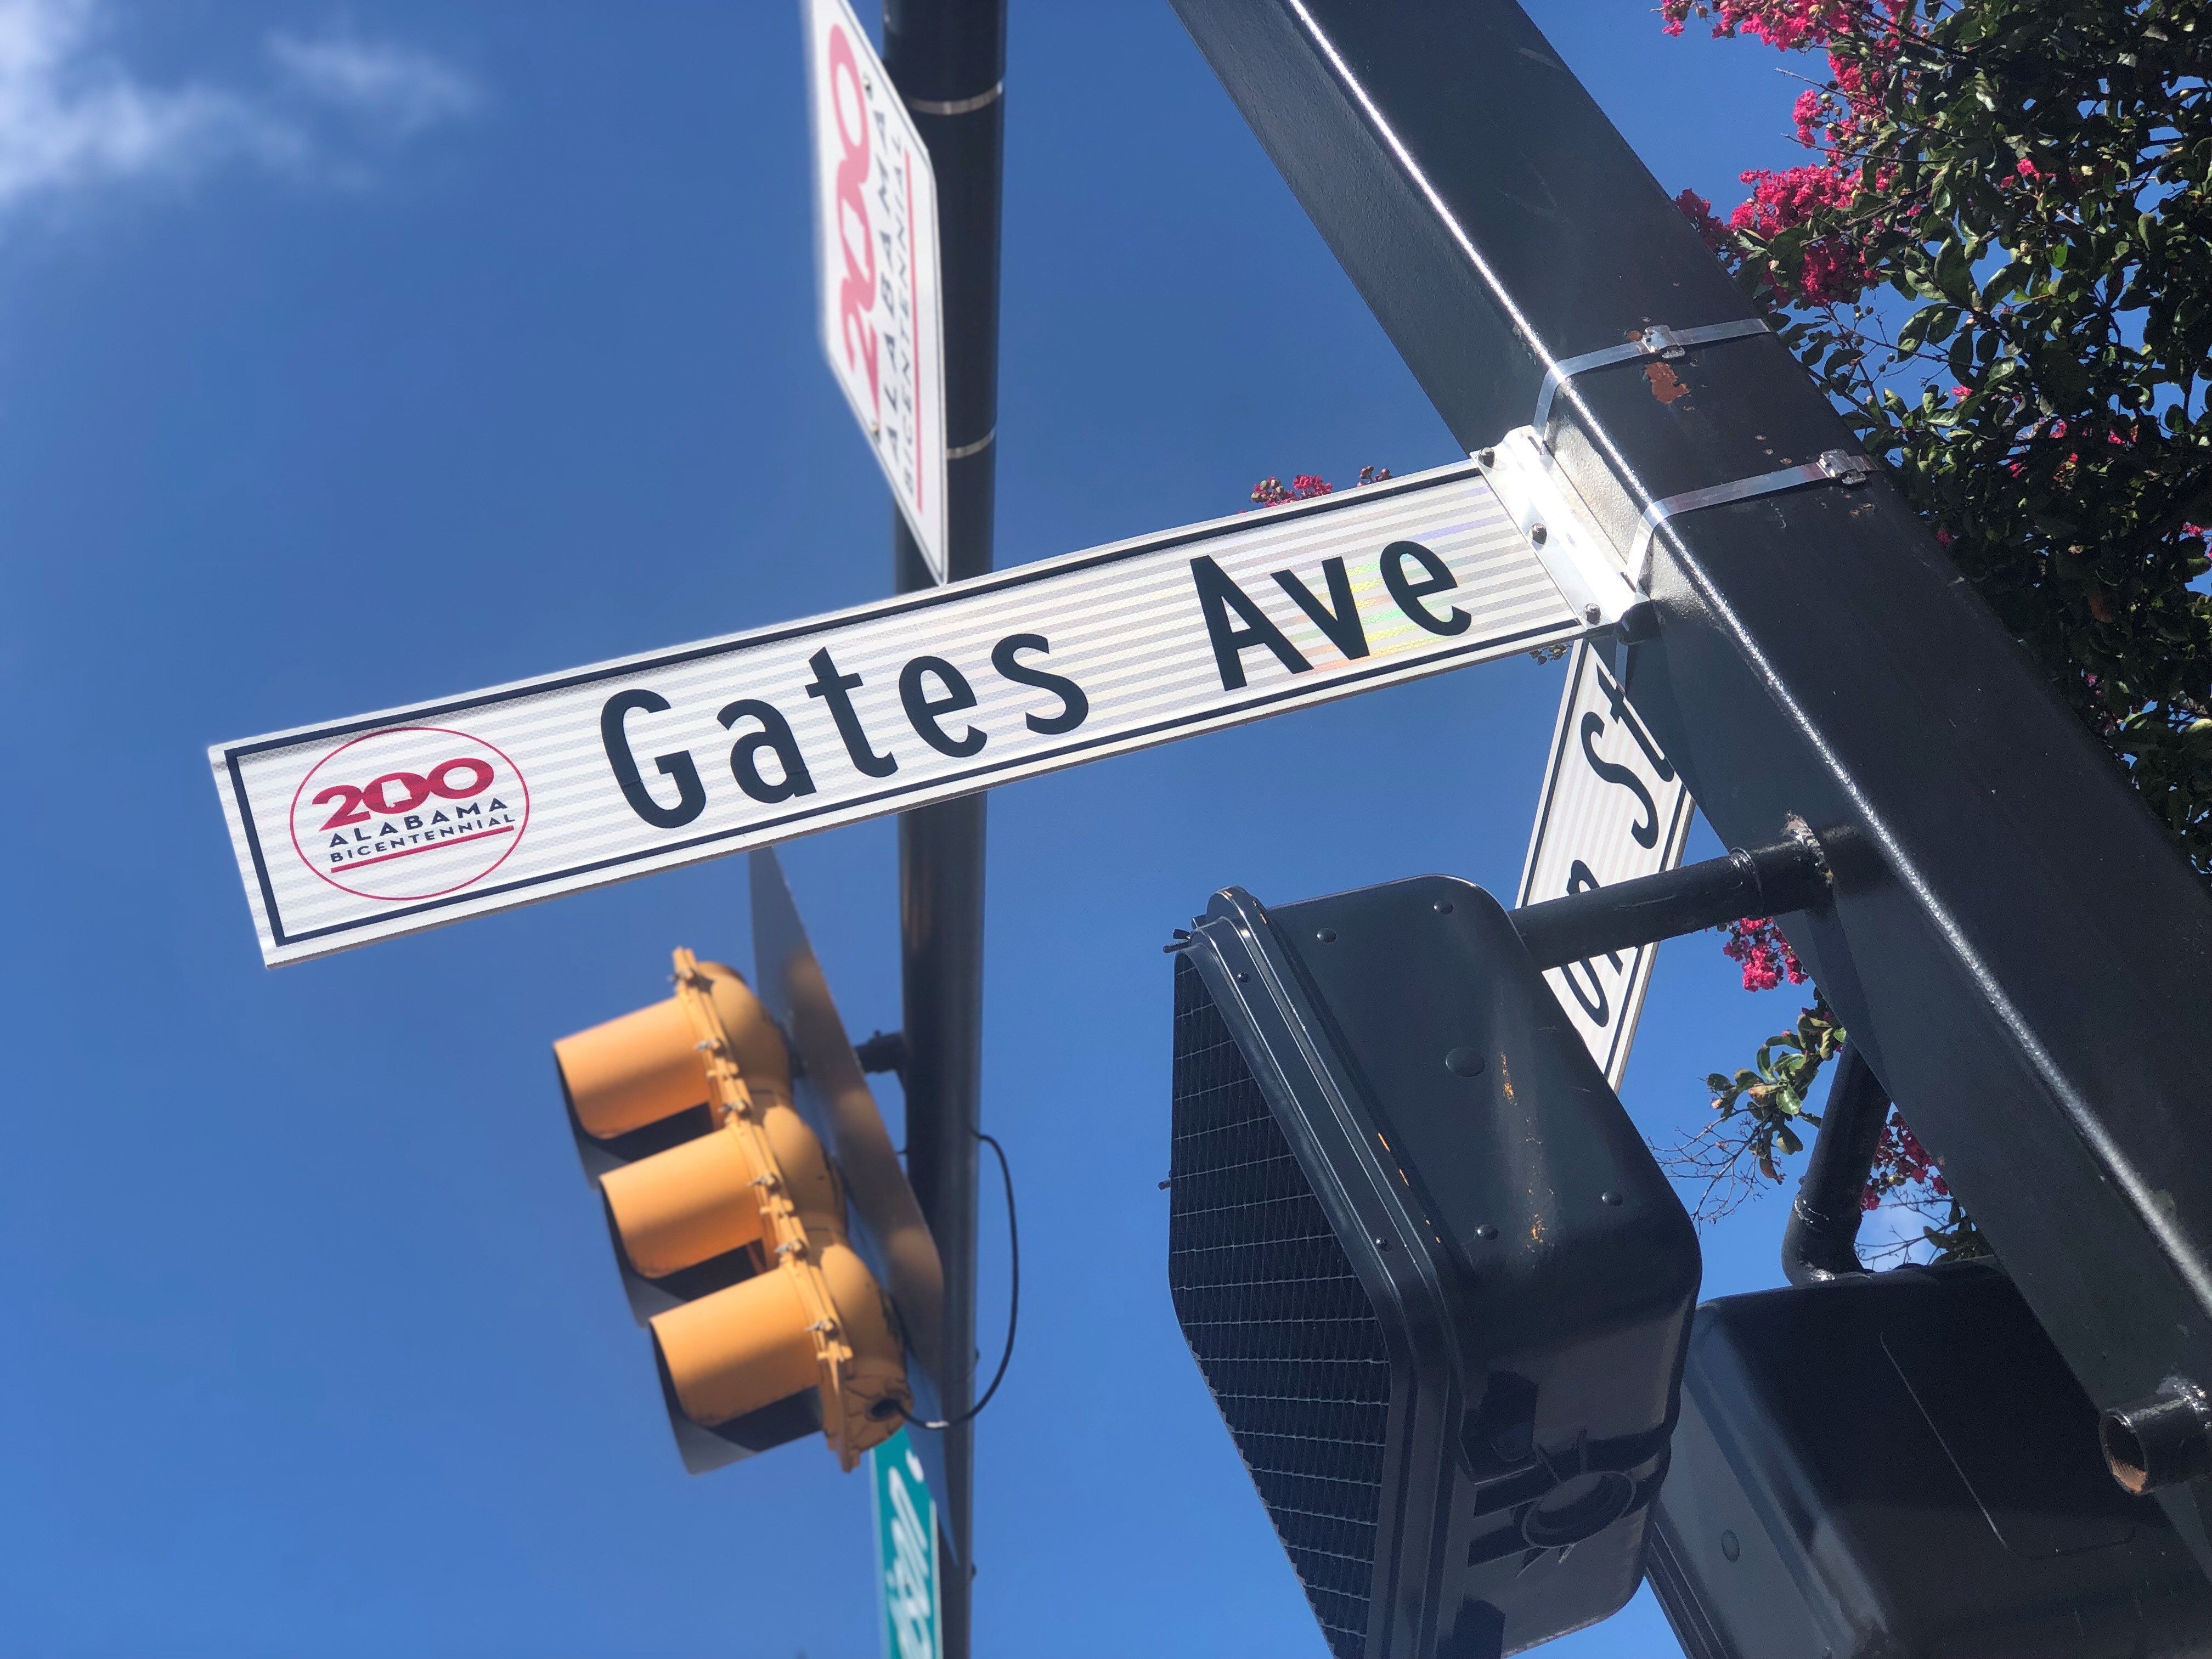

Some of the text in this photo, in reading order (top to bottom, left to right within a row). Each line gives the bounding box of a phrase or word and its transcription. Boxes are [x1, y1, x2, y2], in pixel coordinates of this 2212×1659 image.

[830, 24, 879, 421] 200
[874, 109, 898, 464] ALABAMA
[891, 135, 913, 497] BICENTENNIAL
[313, 758, 494, 831] 200
[600, 540, 1472, 829] Gates Ave
[1581, 663, 1675, 849] St
[330, 798, 507, 848] ALABAMA
[331, 814, 515, 862] BICENTENNIAL
